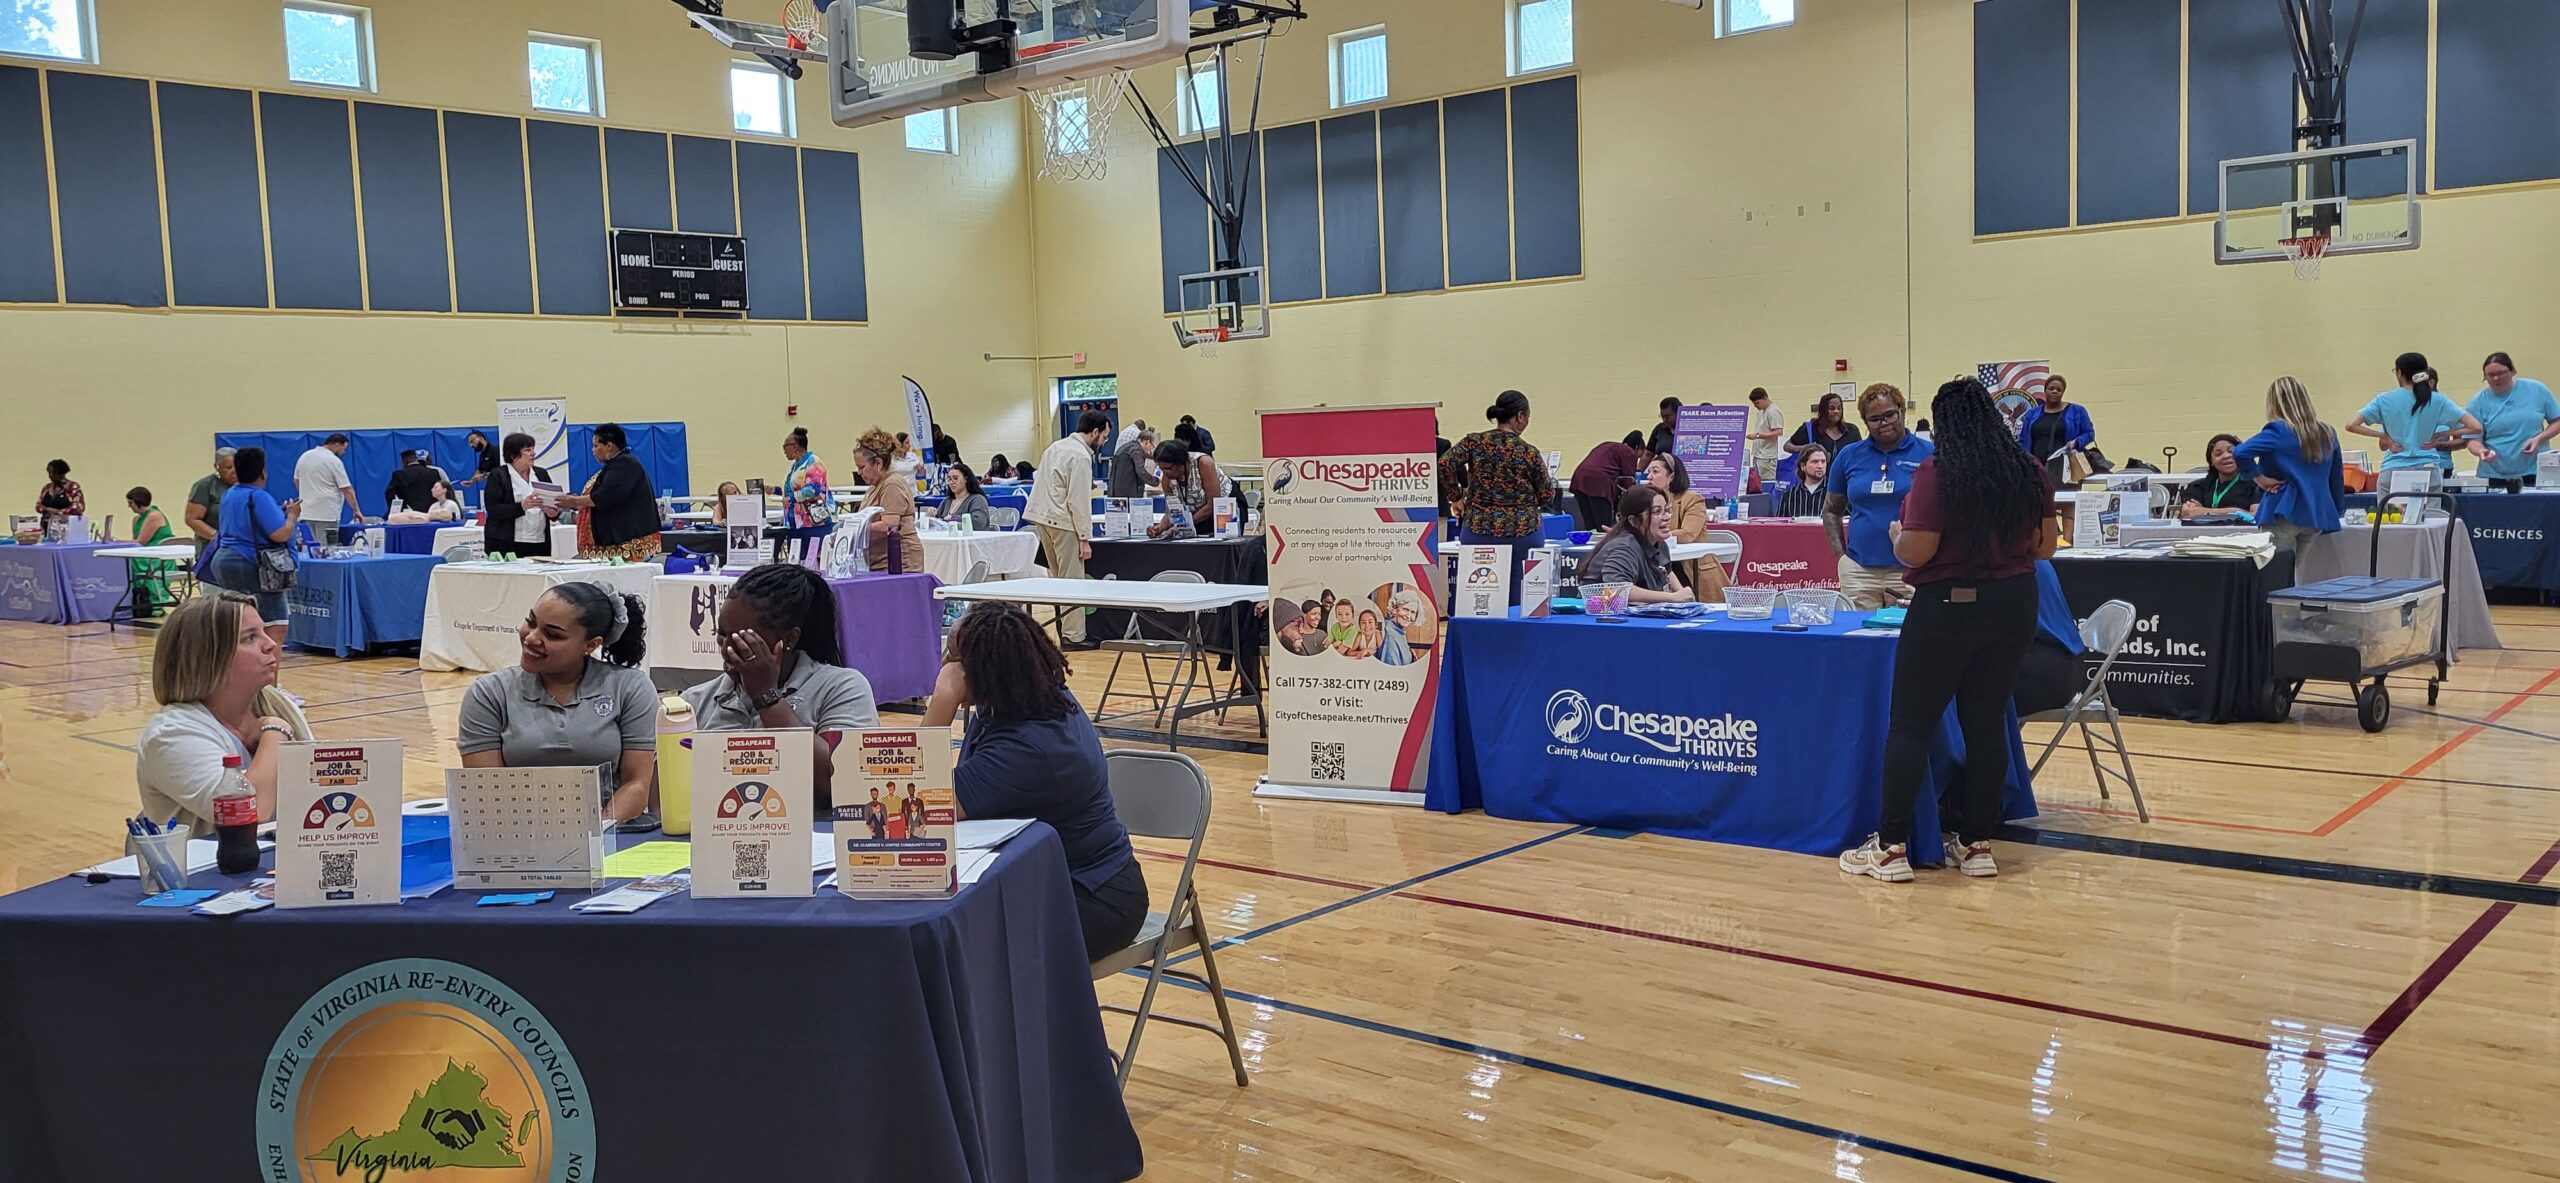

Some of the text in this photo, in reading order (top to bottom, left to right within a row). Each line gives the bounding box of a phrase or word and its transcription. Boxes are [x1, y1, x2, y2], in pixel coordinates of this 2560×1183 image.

[620, 254, 651, 267] HOME
[714, 259, 743, 272] GUEST
[672, 270, 695, 279] PERIOD
[722, 300, 740, 308] BONUS
[913, 390, 924, 442] We're hiring
[1300, 458, 1431, 487] Chesapeake
[1371, 478, 1429, 491] THRIVES
[1268, 494, 1433, 506] Caring About Our Community's Well-Being
[1285, 527, 1330, 536] Connecting
[2473, 527, 2544, 540] SCIENCES
[1301, 541, 1315, 550] any
[1317, 541, 1339, 550] stage
[1340, 540, 1350, 548] of
[1350, 540, 1362, 548] life
[1364, 540, 1395, 550] through
[1397, 540, 1411, 548] the
[1309, 553, 1393, 564] power of partnerships
[1561, 555, 1579, 570] ity
[1746, 560, 1808, 574] Chesapeake
[1756, 579, 1802, 590] Behavioral
[1803, 578, 1841, 589] Healthca
[2136, 615, 2160, 632] of
[2166, 638, 2206, 656] Inc.
[2086, 666, 2194, 686] Communities.
[1275, 676, 1409, 693] Call 757-382-CITY (2489)
[1319, 697, 1363, 708] or Visit:
[1275, 711, 1409, 724] CityofChesapeake.net/Thrives
[1594, 704, 1758, 749] Chesapeake
[728, 739, 771, 747] CHESAPEAKE
[863, 736, 912, 744] CHESAPEAKE
[314, 750, 360, 759] CHESAPEAKE
[897, 748, 904, 756] &
[1682, 738, 1758, 758] THRIVES
[739, 751, 756, 759] JOB
[866, 756, 916, 765] RESOURCE
[1546, 744, 1758, 776] Caring About Our Community's Well-Being
[326, 761, 352, 770] JOB &
[729, 758, 774, 766] RESOURCE
[316, 768, 361, 777] RESOURCE
[298, 832, 379, 842] HELP US IMPROVE!
[270, 971, 580, 1120] STATE OF VIRGINIA RE-ENTRY COUNCILS
[269, 1144, 288, 1183] ENH
[335, 1138, 437, 1183] Virginia
